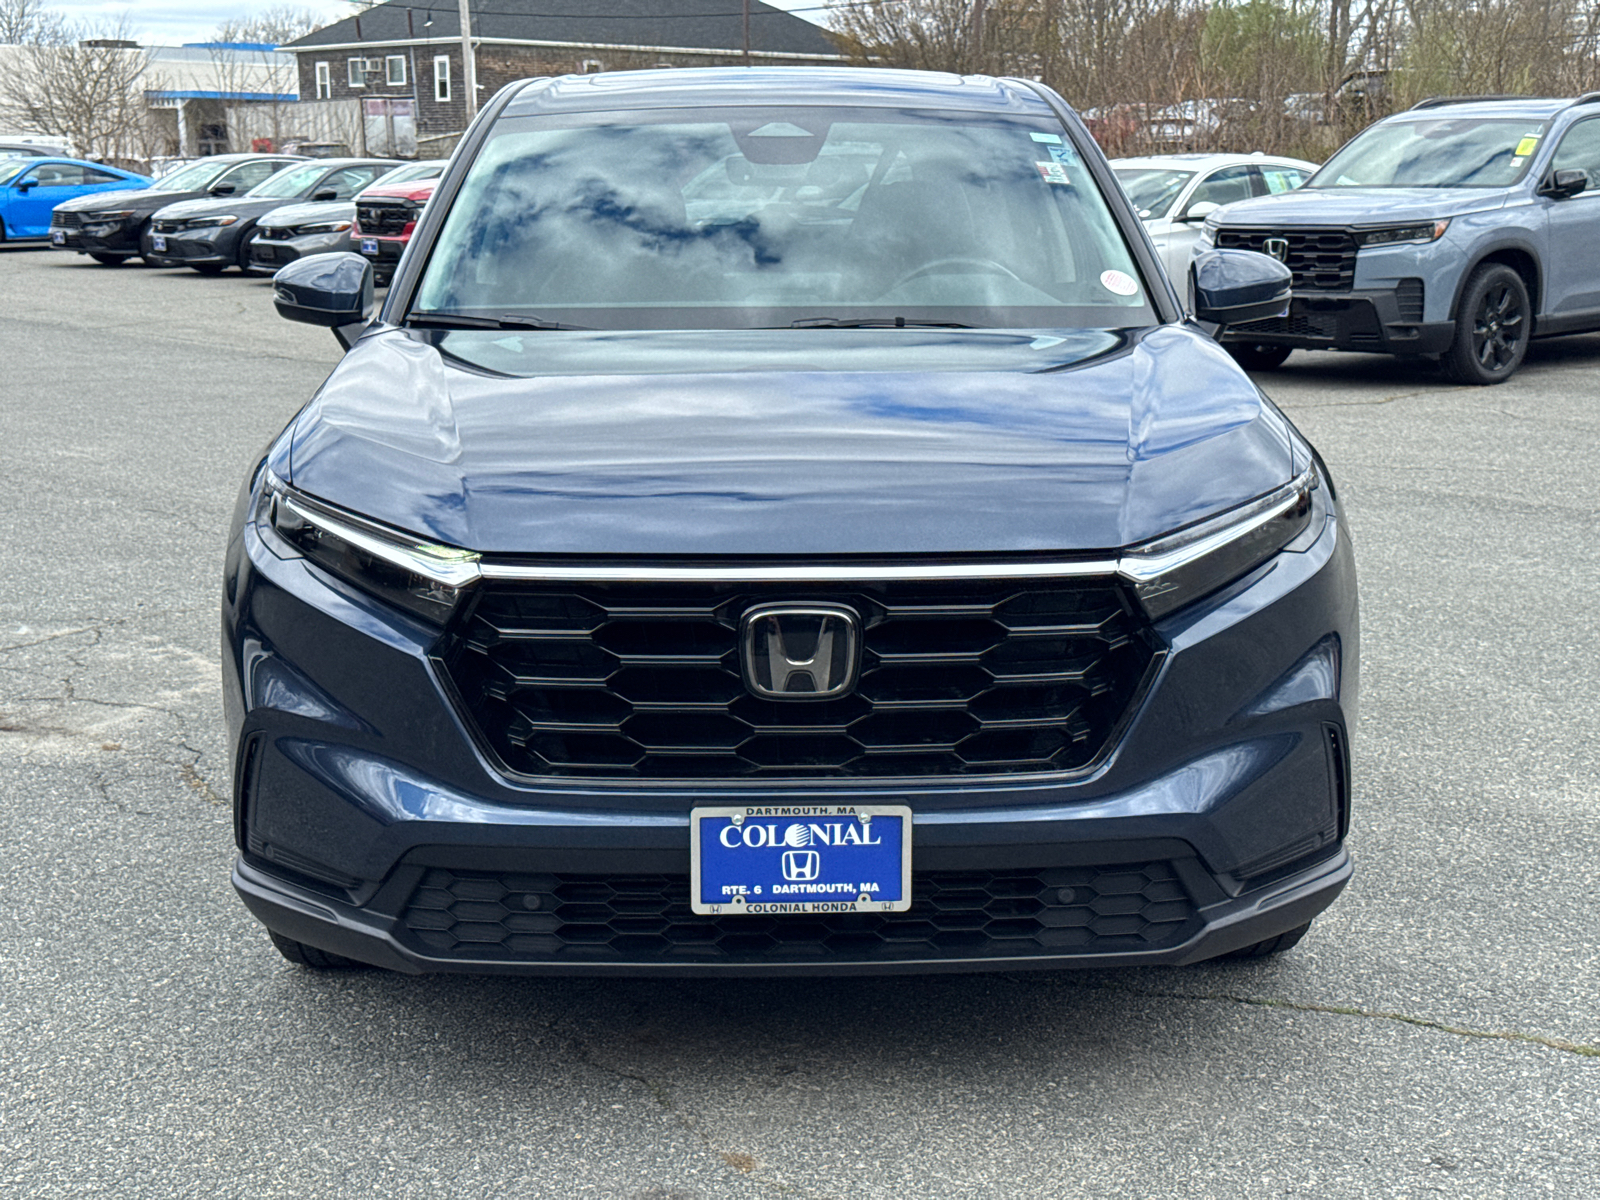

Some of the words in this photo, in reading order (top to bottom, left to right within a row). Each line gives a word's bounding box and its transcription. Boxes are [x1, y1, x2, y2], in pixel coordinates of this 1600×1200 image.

[837, 806, 857, 815] MA
[719, 823, 881, 848] COLONIAL
[721, 885, 751, 895] RTE.
[753, 885, 762, 895] 6
[772, 884, 857, 894] DARTMOUTH,
[860, 882, 880, 893] MA
[746, 904, 808, 913] COLONIAL
[812, 902, 857, 912] HONDA
